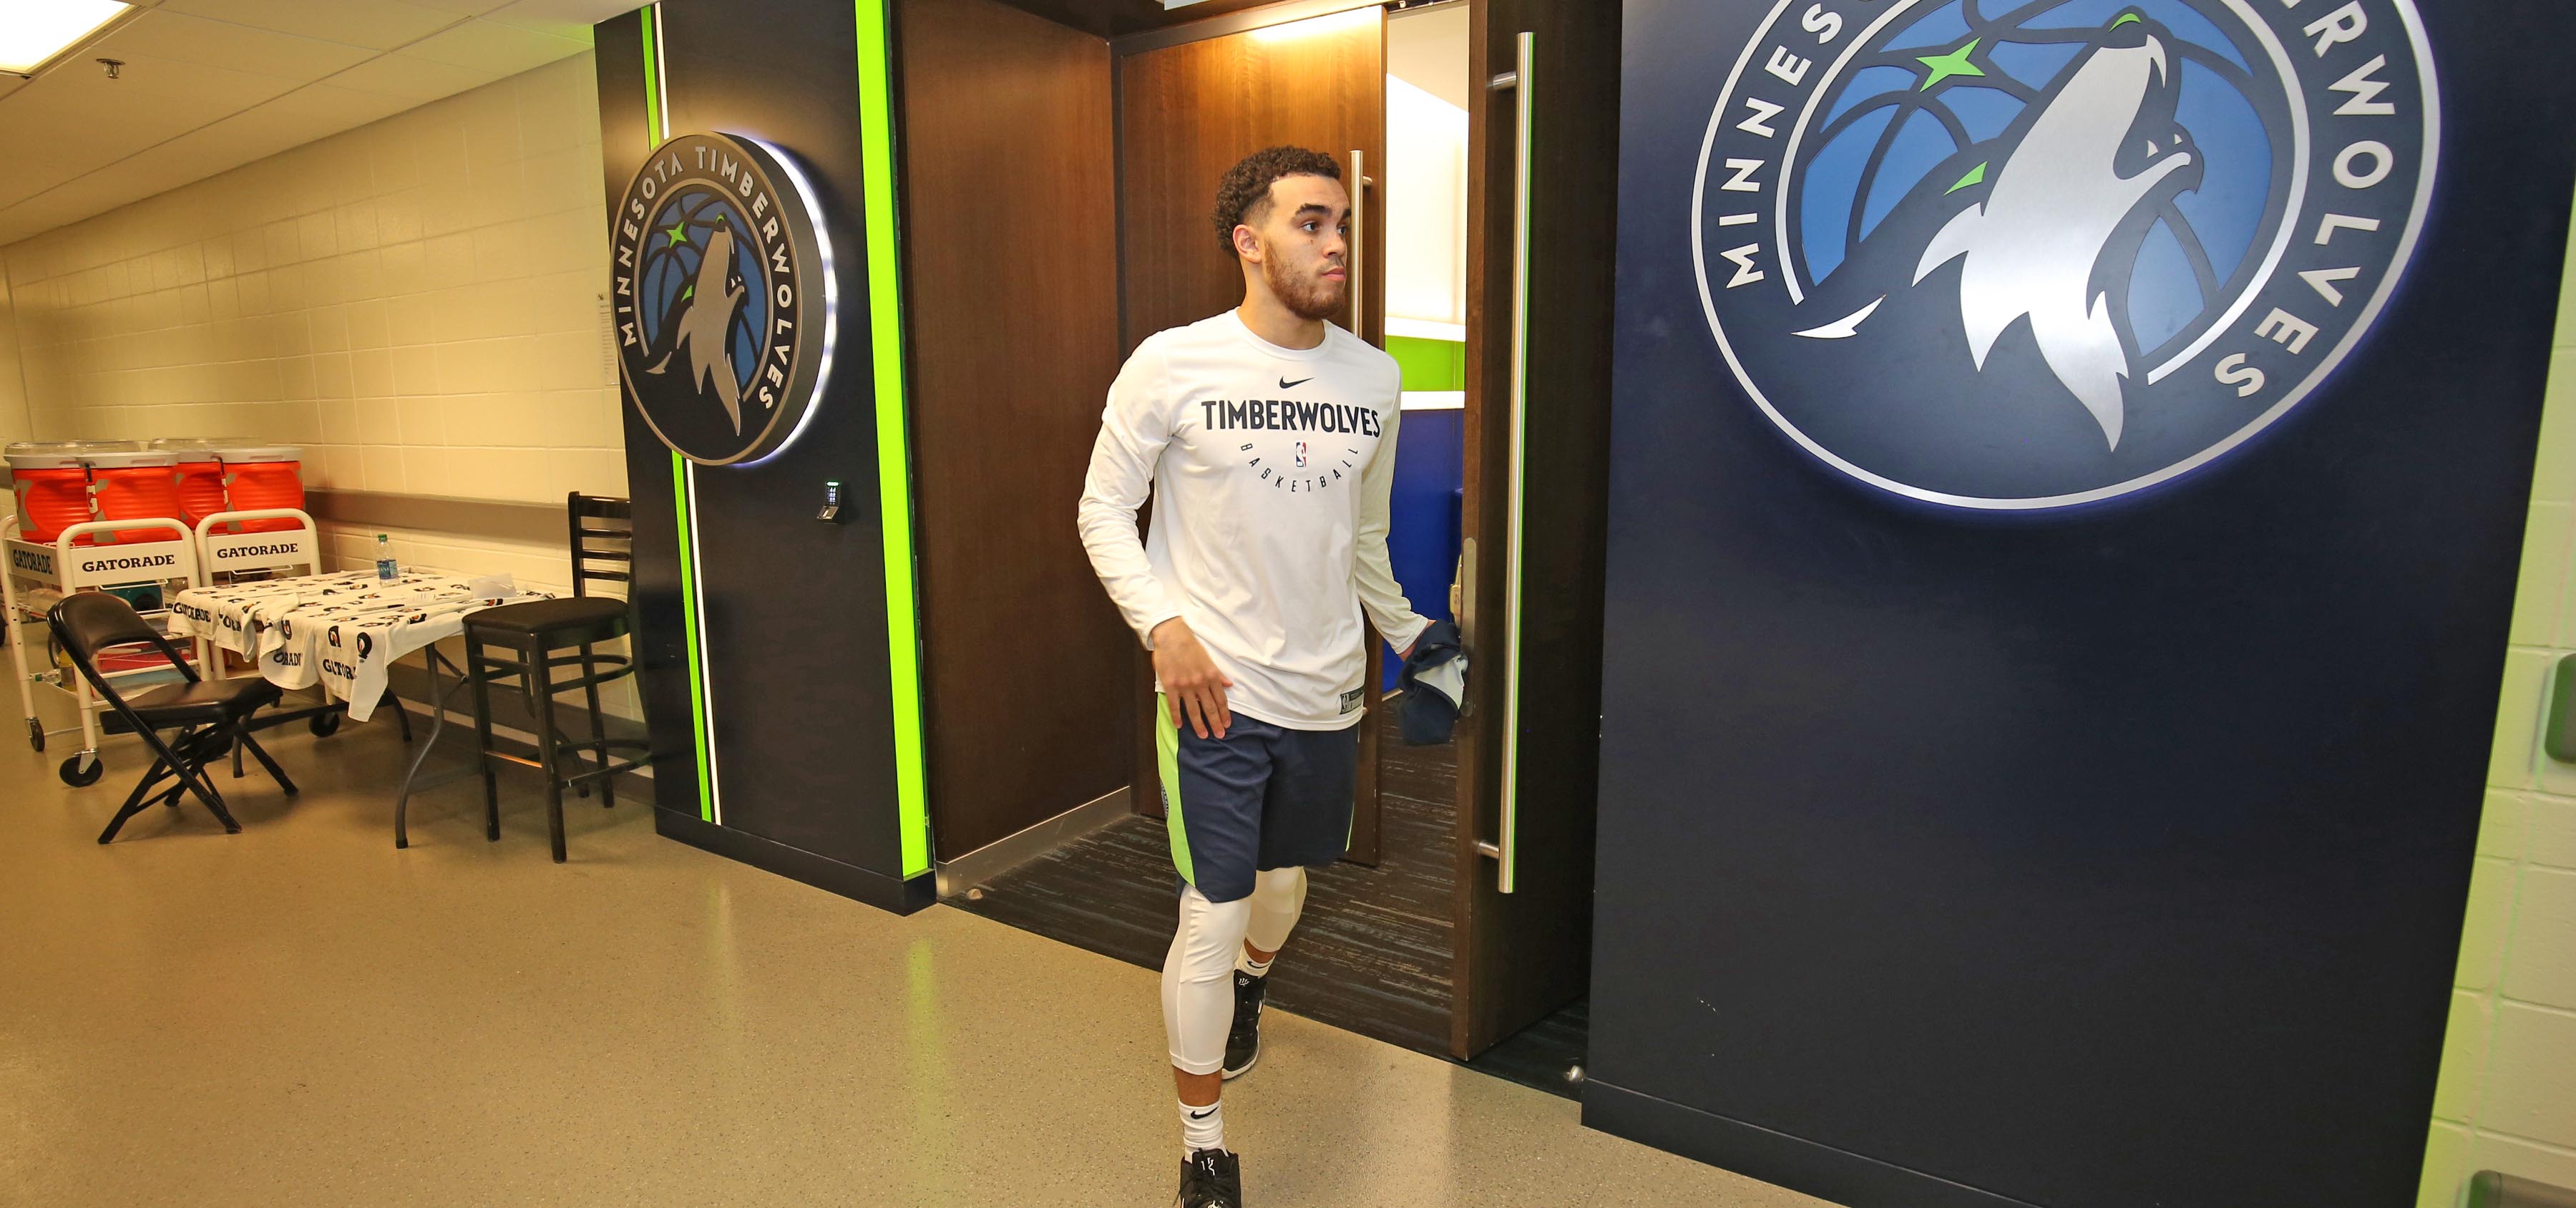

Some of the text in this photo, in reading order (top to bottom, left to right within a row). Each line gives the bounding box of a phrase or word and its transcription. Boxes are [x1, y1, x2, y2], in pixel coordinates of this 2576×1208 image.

[1720, 0, 1845, 288] MINNES
[2214, 0, 2396, 397] RWOLVES
[618, 145, 793, 409] MINNESOTA TIMBERWOLVES
[1201, 399, 1381, 438] TIMBERWOLVES
[1240, 442, 1359, 492] BASKETBALL
[13, 548, 54, 575] GATORADE
[82, 554, 175, 573] GATORADE
[216, 542, 298, 560] GATORADE
